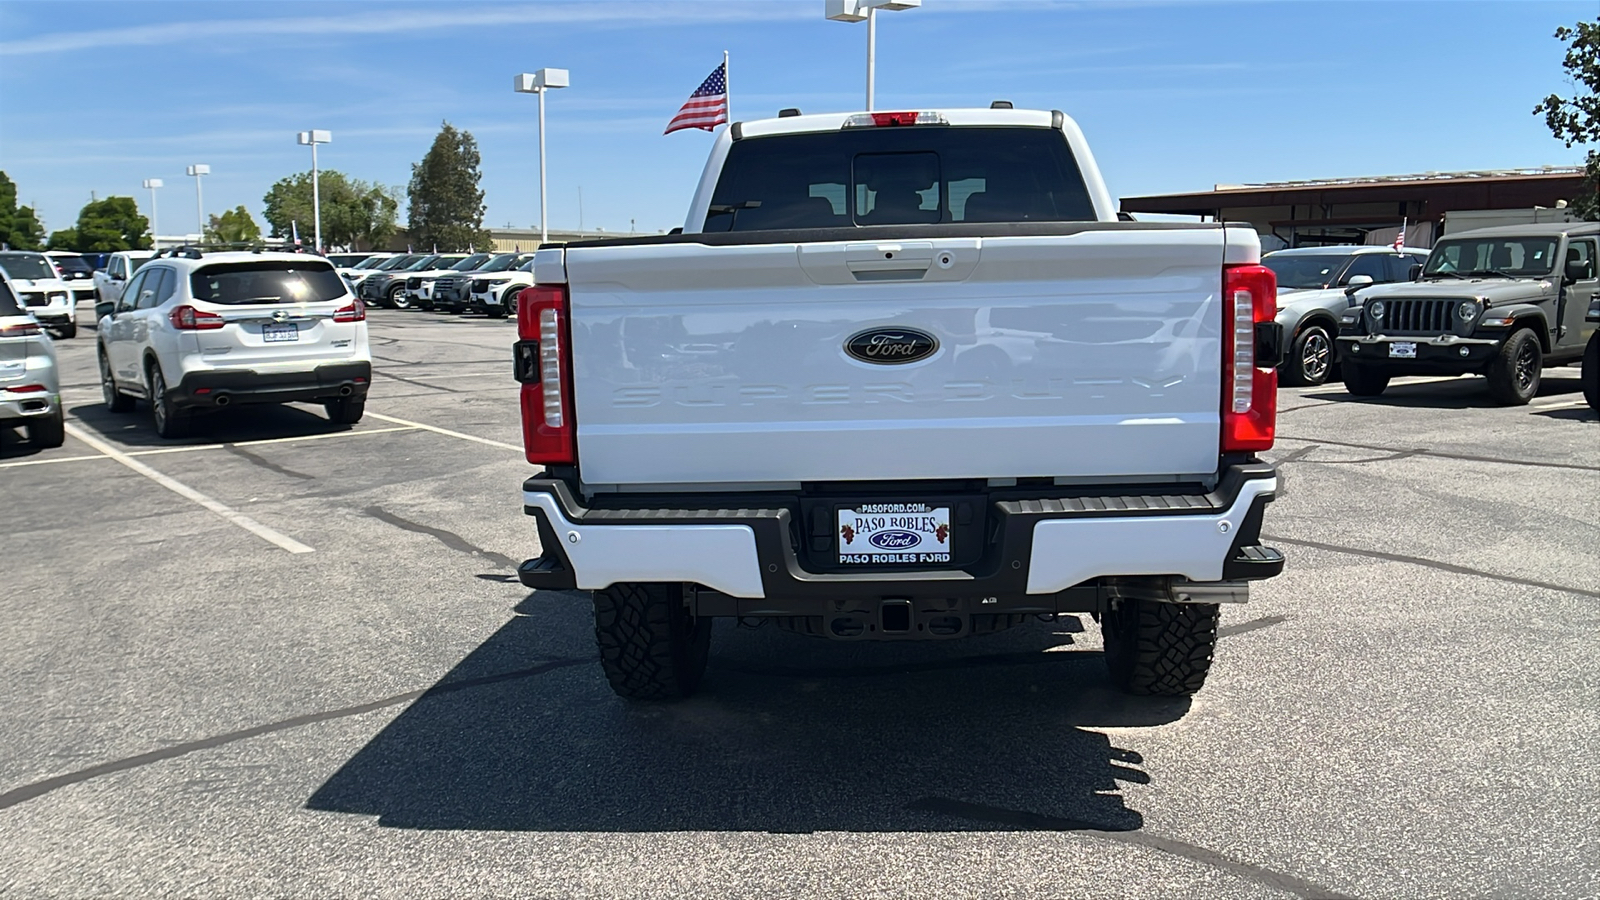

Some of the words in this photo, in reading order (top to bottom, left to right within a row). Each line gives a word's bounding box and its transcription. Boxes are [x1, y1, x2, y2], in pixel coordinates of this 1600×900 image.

[865, 333, 917, 356] Ford
[612, 383, 914, 408] SUPER
[942, 374, 1184, 402] DUTY
[861, 503, 925, 513] PASOFORD.COM
[855, 517, 885, 534] PASO
[890, 516, 936, 533] ROBLES
[879, 533, 912, 546] Ford
[839, 554, 869, 564] PASO
[872, 553, 917, 563] ROBLES
[919, 552, 950, 563] FORD
